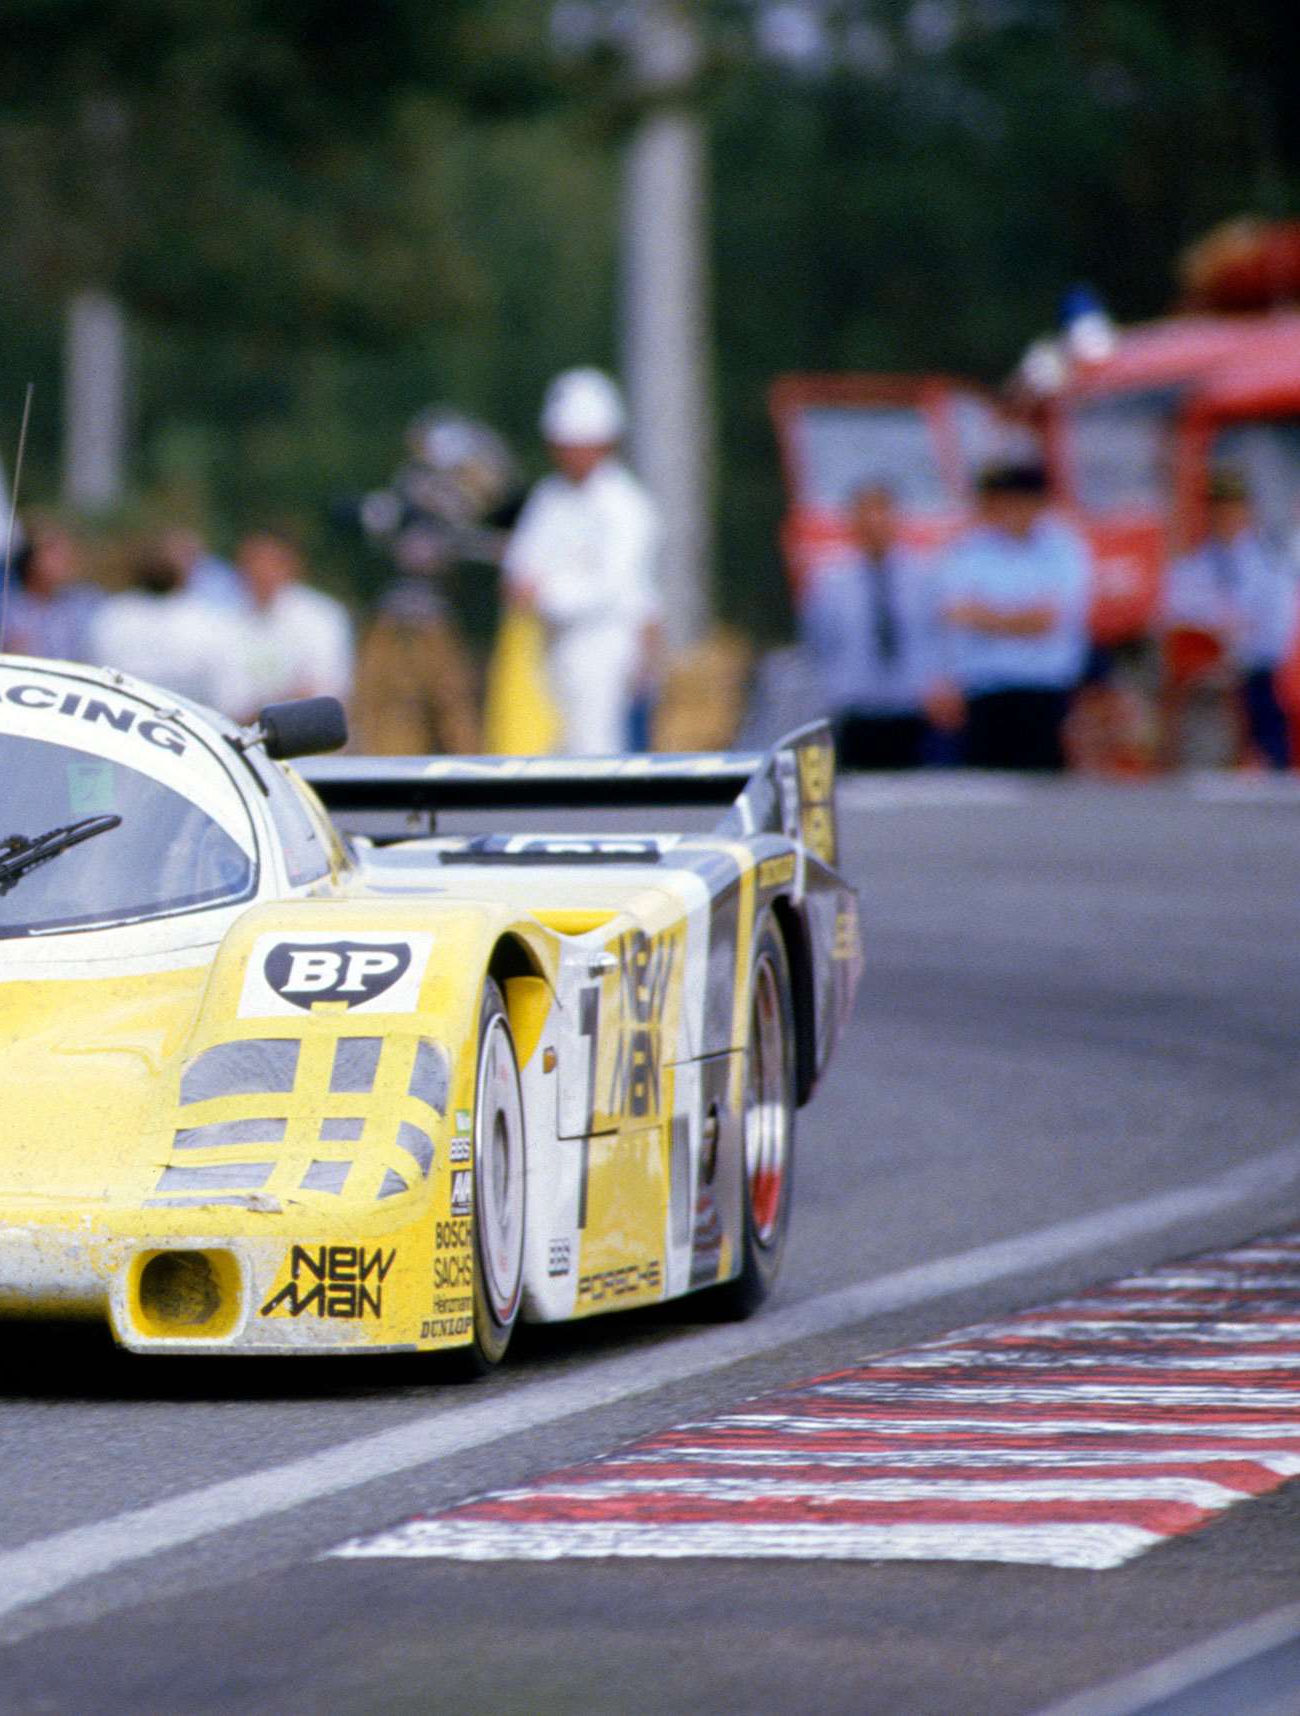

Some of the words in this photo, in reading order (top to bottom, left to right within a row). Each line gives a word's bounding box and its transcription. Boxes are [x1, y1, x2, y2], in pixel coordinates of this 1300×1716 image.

[280, 951, 399, 993] BP
[435, 1221, 474, 1249] BOSCH
[433, 1255, 472, 1289] SACHS
[580, 1260, 660, 1300] PORSCHE
[420, 1316, 473, 1339] DUNLOP
